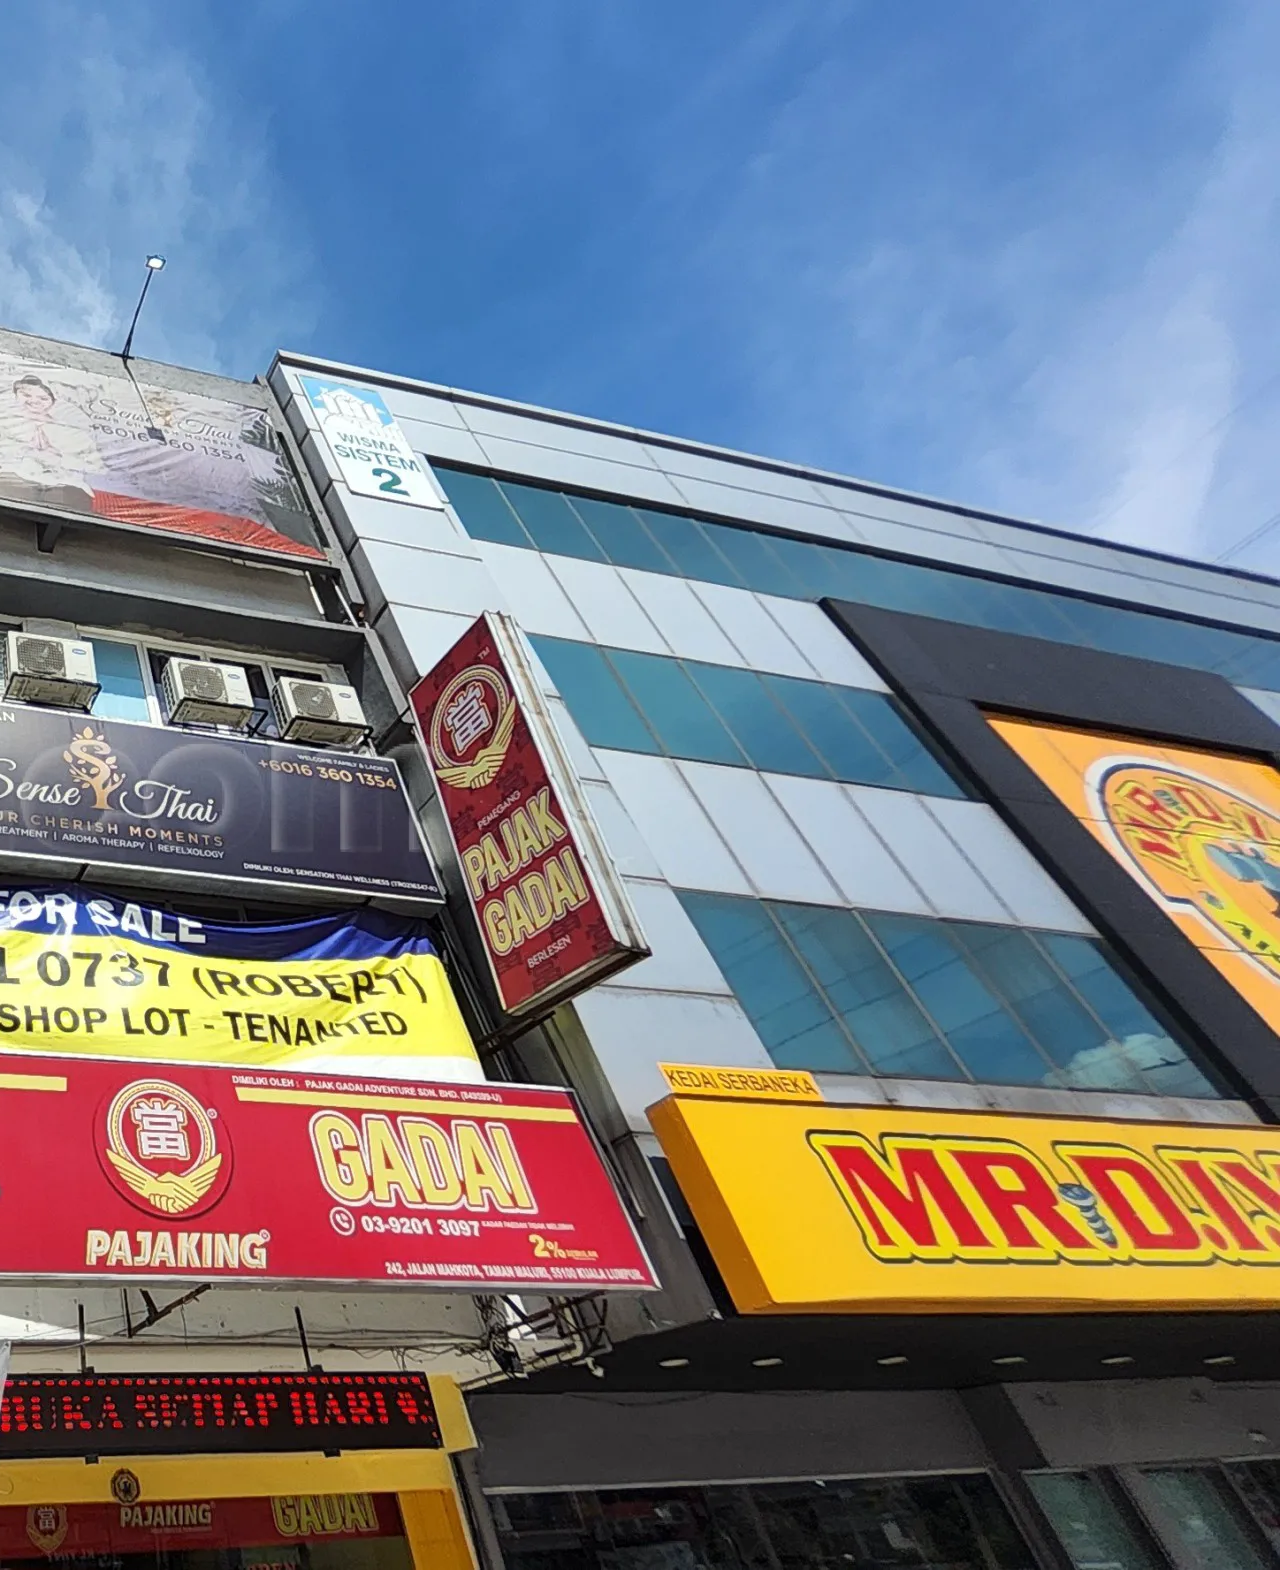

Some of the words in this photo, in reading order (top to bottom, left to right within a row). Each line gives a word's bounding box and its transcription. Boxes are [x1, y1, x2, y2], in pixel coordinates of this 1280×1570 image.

[201, 445, 246, 463] 1354
[334, 444, 422, 473] SISTEM
[336, 431, 402, 454] WISMA
[372, 467, 411, 497] 2
[257, 758, 313, 777] +6016
[316, 766, 353, 783] 360
[355, 772, 397, 790] 1354
[120, 780, 218, 823] Thai
[30, 814, 119, 835] CHERISH
[129, 825, 224, 847] MOMENTS
[62, 833, 100, 846] AROMA
[101, 836, 146, 851] THERAPY
[461, 785, 567, 902] PAJAK
[483, 845, 590, 957] GADAI
[88, 899, 207, 944] SALE
[36, 950, 170, 988] 0737
[193, 964, 428, 1004] (ROBERT)
[123, 1007, 191, 1037] LOT
[665, 1068, 719, 1089] KEDAI
[718, 1073, 819, 1095] SERBANEKA
[308, 1109, 538, 1215] GADAI
[808, 1132, 1105, 1262] MR
[361, 1215, 433, 1236] 03-9201
[438, 1218, 481, 1237] 3097
[86, 1229, 267, 1270] PAJAKING
[406, 1263, 436, 1276] JALAN
[120, 1503, 213, 1528] PAJAKING
[270, 1492, 380, 1538] GADAI
